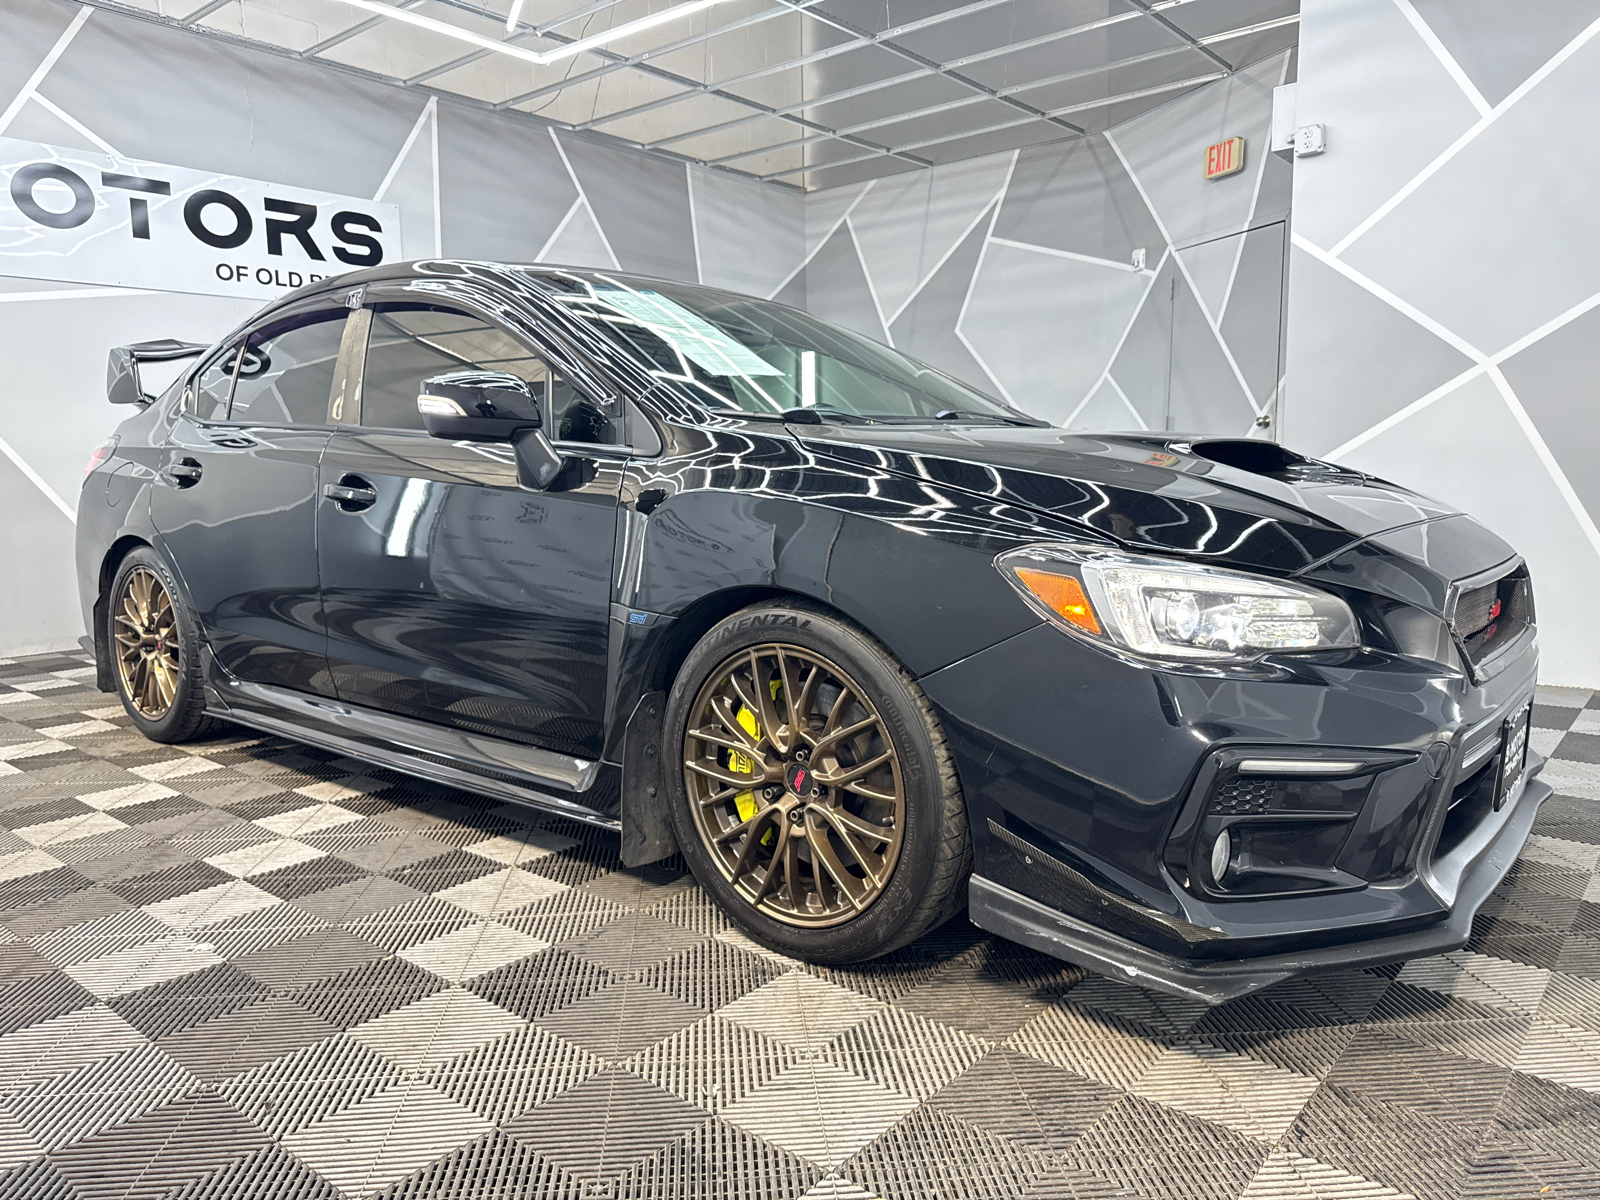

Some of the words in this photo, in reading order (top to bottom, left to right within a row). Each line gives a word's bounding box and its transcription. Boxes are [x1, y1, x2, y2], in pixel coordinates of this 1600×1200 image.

[1208, 140, 1235, 176] EXIT
[215, 263, 249, 283] OF
[255, 268, 303, 288] OLD
